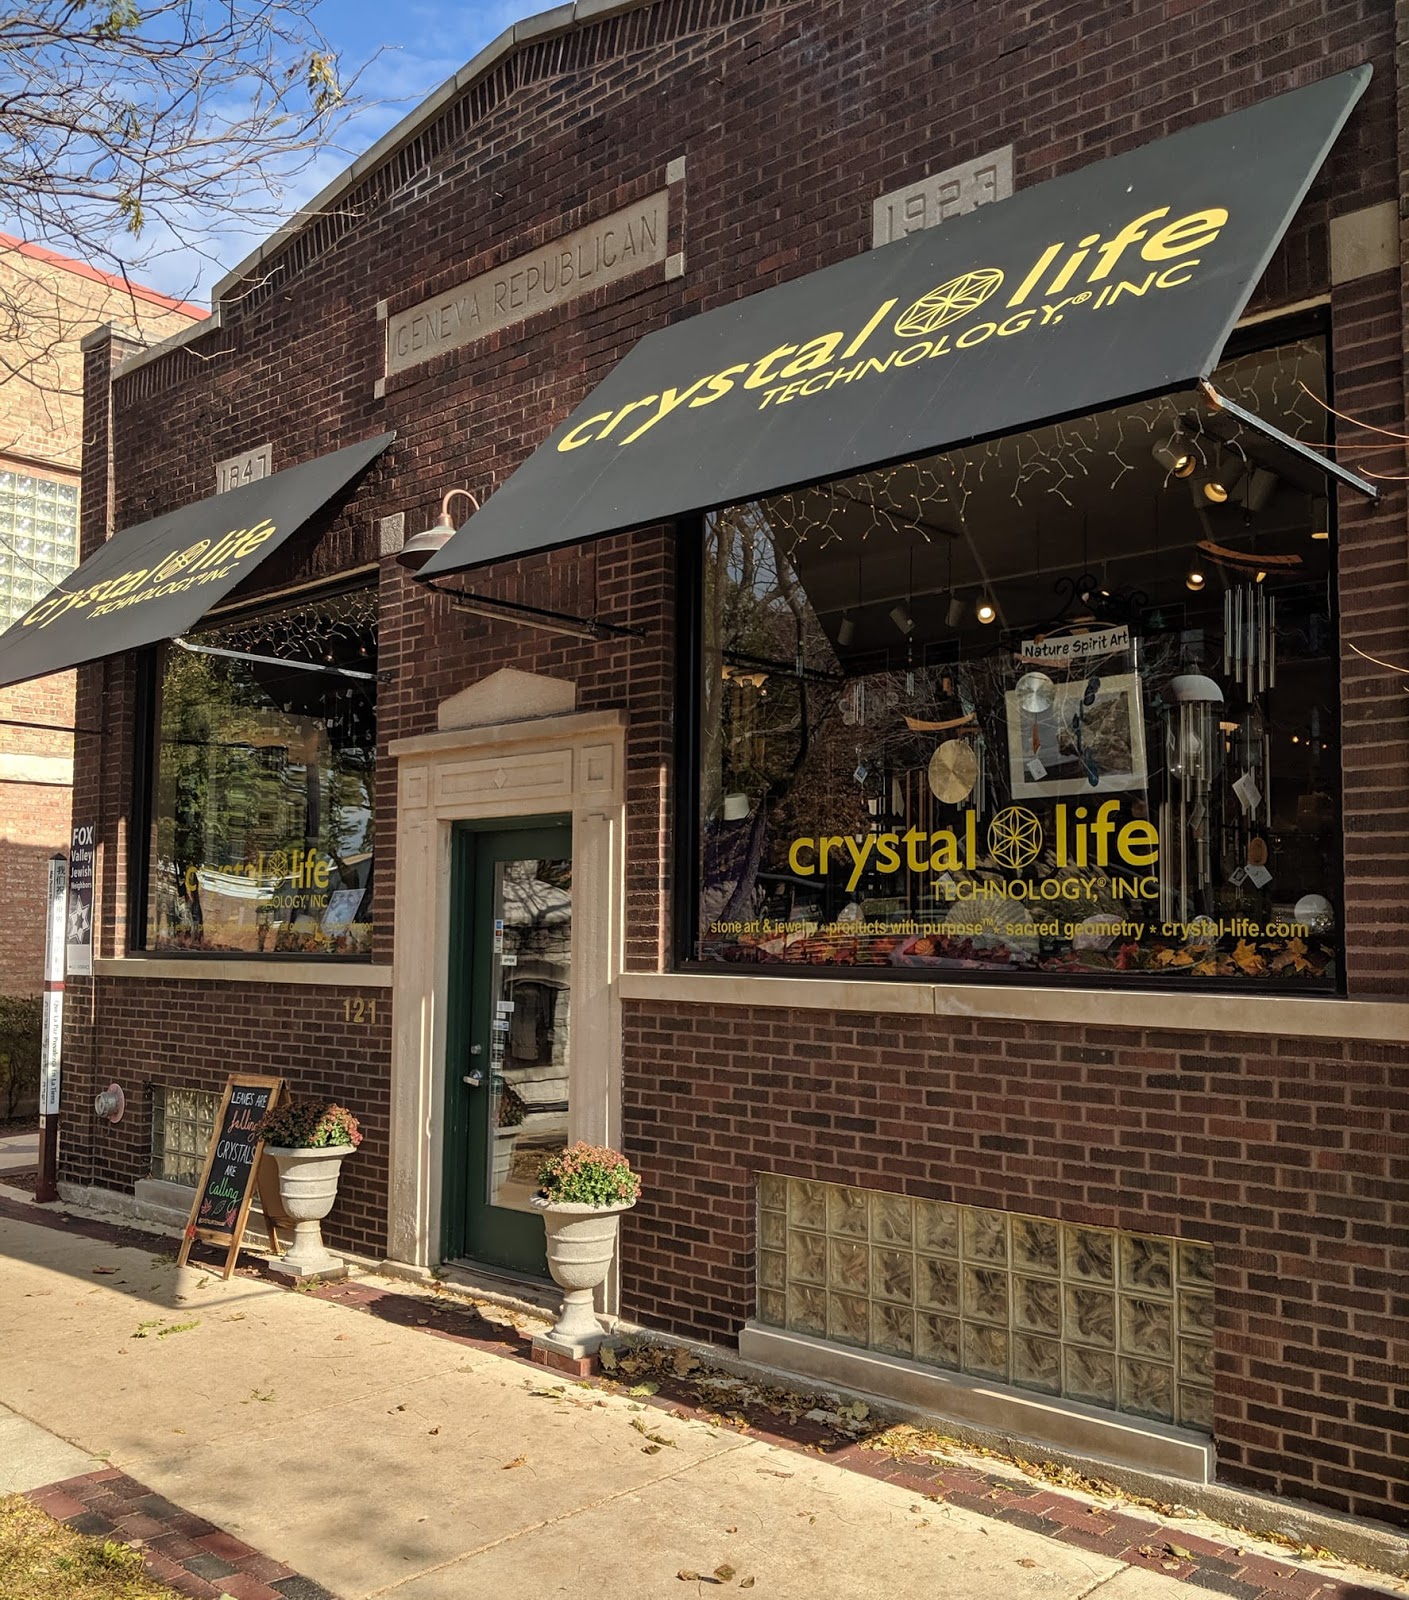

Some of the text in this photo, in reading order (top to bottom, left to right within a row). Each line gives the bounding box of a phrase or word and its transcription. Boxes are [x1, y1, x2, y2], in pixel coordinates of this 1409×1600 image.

[396, 209, 658, 357] GENEVA REPUBLICAN
[1092, 259, 1201, 310] INC
[557, 206, 1229, 452] crystal life
[22, 518, 276, 629] crystal life
[197, 562, 240, 586] INC
[1025, 630, 1128, 658] Nature Spirit Art
[72, 826, 93, 846] FOX
[788, 800, 1160, 893] crystal life
[70, 849, 93, 863] Valley
[70, 866, 92, 878] Jewish
[291, 848, 330, 889] life
[70, 881, 92, 891] Neighbors
[1111, 876, 1159, 900] INC
[310, 894, 328, 908] INC
[710, 919, 741, 934] stone
[743, 920, 760, 933] art
[762, 919, 773, 933] &
[774, 919, 818, 937] jewelry
[828, 919, 886, 937] products
[890, 919, 919, 934] with
[1005, 919, 1059, 936] sacred
[1063, 920, 1145, 941] geometry
[1162, 918, 1309, 941] crystal-life.com
[342, 996, 377, 1024] 121
[51, 1078, 57, 1086] La
[231, 1091, 268, 1109] LEAVES ARE
[216, 1139, 257, 1165] CRYSTALS
[223, 1165, 238, 1178] ARE
[208, 1177, 243, 1213] calling
